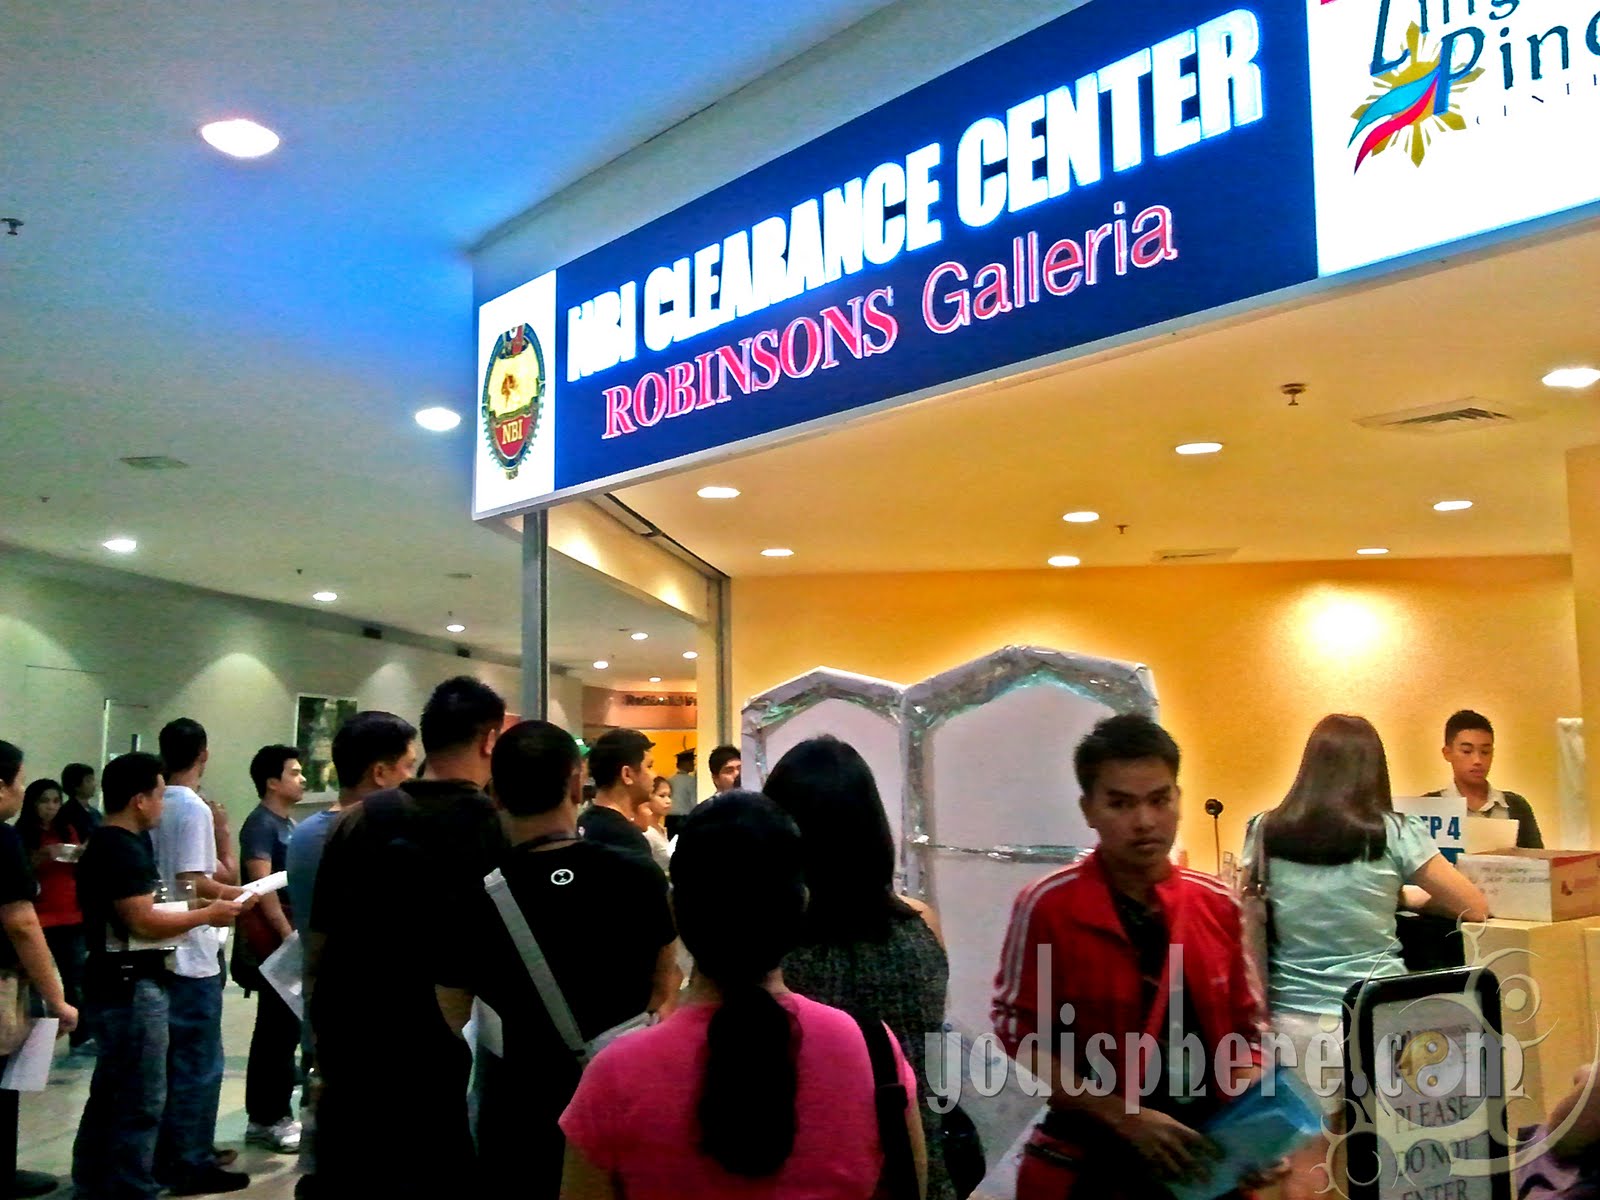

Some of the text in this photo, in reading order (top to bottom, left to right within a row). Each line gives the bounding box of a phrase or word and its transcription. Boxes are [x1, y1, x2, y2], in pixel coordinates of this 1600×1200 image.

[567, 8, 1264, 382] NBI CLEARANCE CENTER
[601, 201, 1179, 440] ROBINSONS Galleria
[501, 418, 524, 446] NBI
[1447, 816, 1461, 841] 4
[1395, 1096, 1469, 1135] PLEASE
